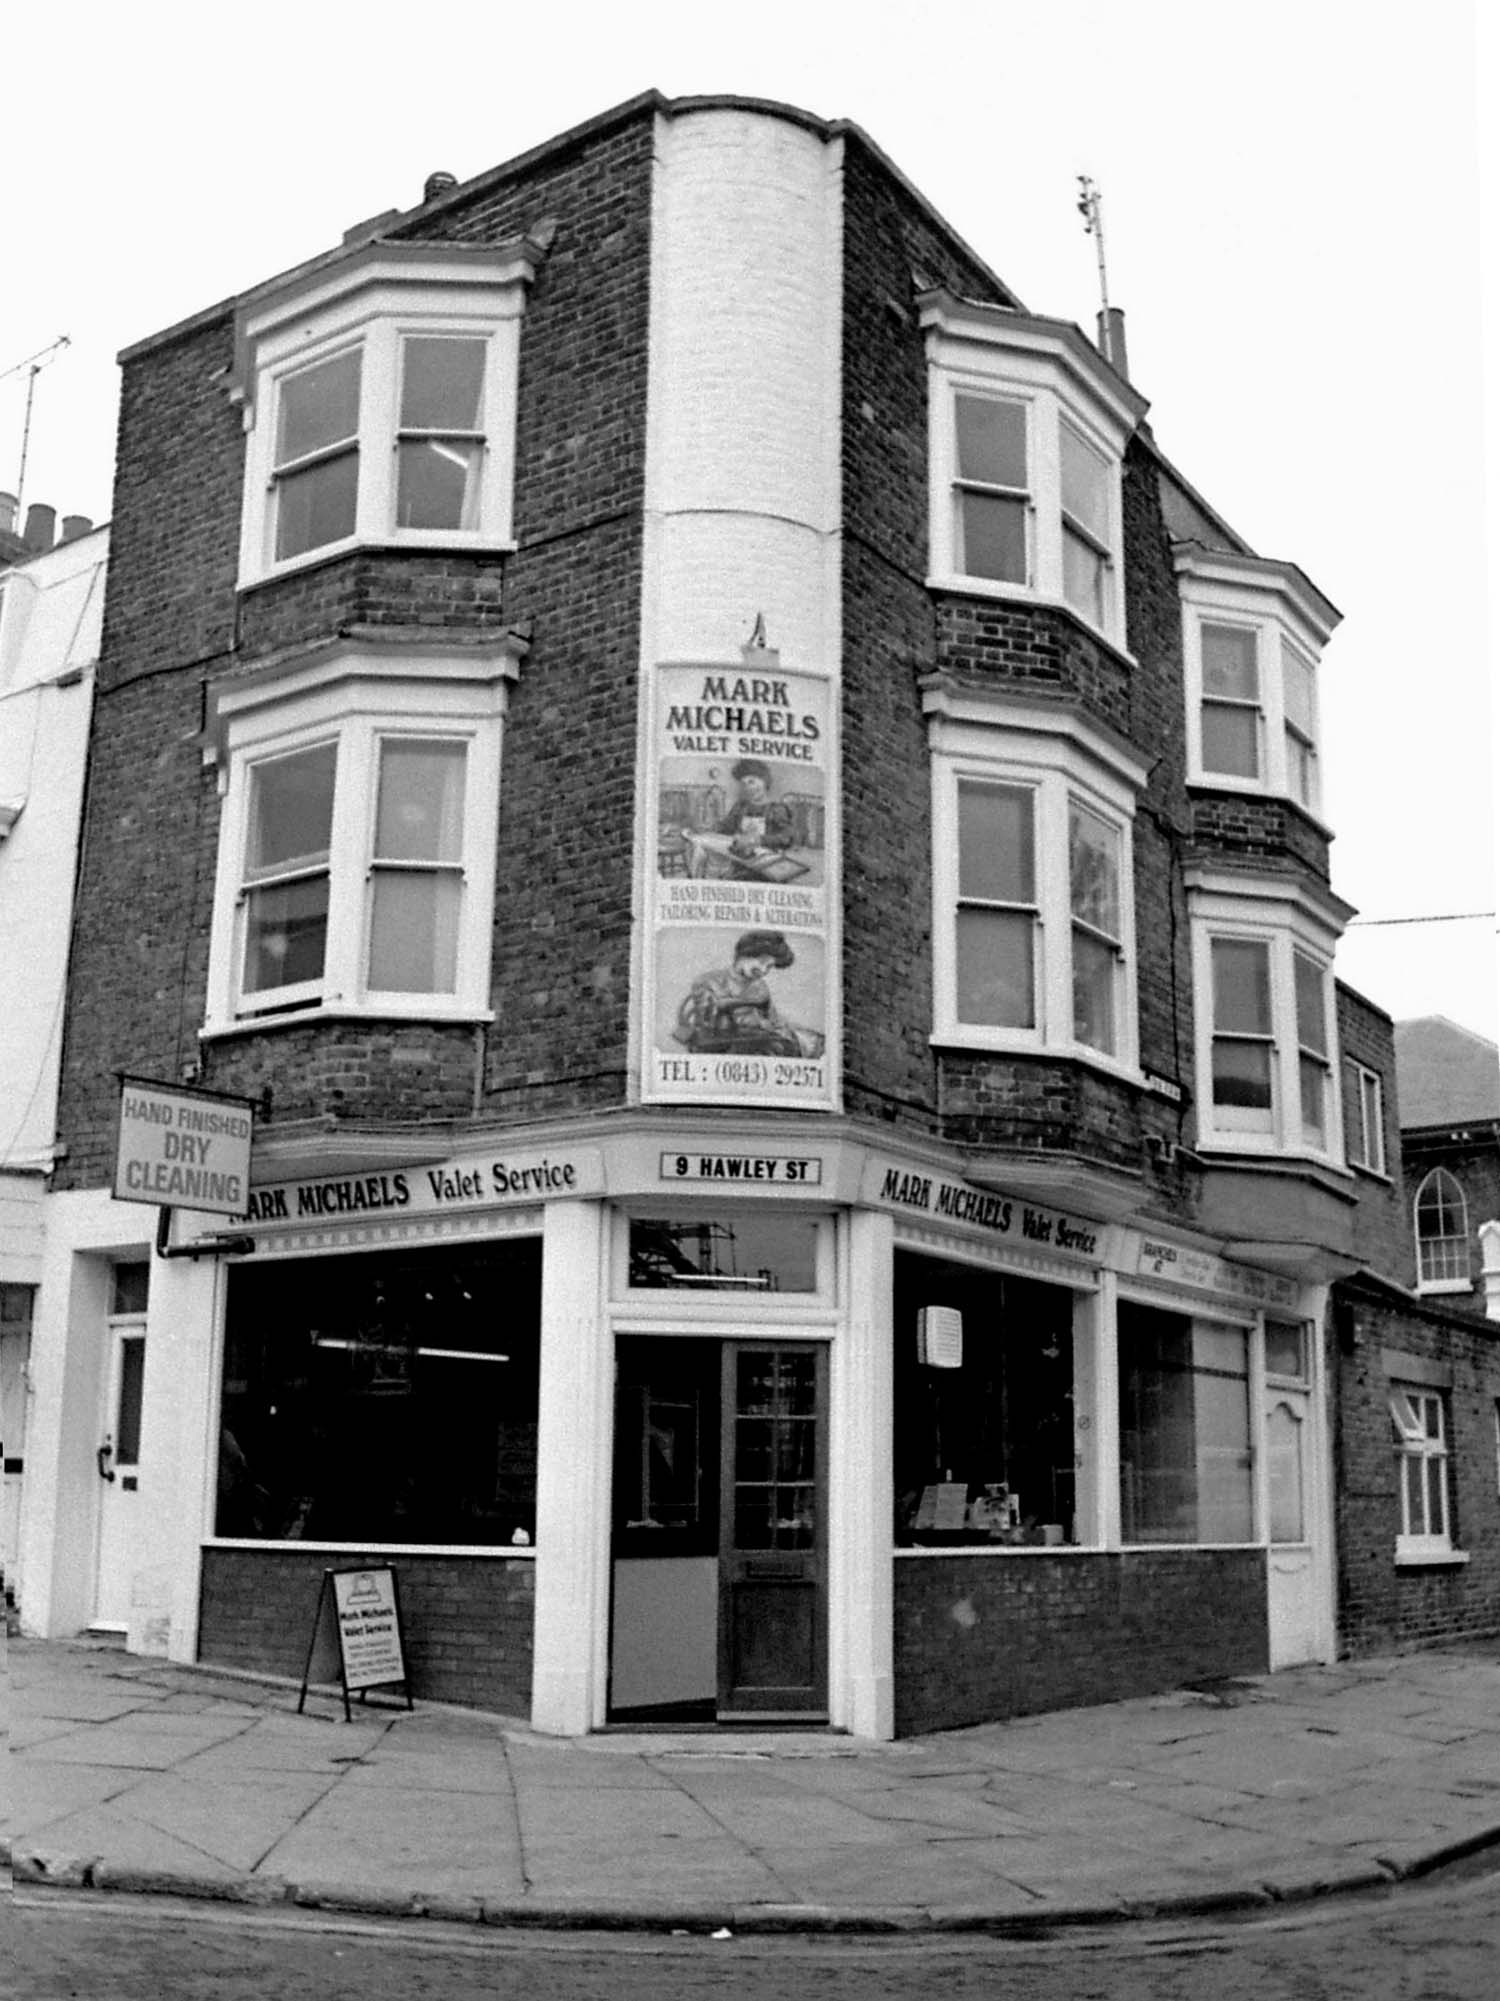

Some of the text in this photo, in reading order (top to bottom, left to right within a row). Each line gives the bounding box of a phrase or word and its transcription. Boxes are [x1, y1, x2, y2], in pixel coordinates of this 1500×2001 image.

[701, 676, 790, 707] MARK
[665, 705, 820, 740] MICHAELS
[672, 735, 813, 761] VALET SERVICE
[714, 1061, 768, 1085] (0843)
[124, 1097, 249, 1139] HAND FINISHED
[164, 1131, 212, 1165] DRY
[126, 1160, 241, 1203] CLEANING
[676, 1156, 808, 1180] 9 HAWLEY ST
[229, 1160, 576, 1225] ARK MICHAELS Valet Service
[880, 1168, 932, 1208] MARK
[934, 1184, 1013, 1232] MICHAELS
